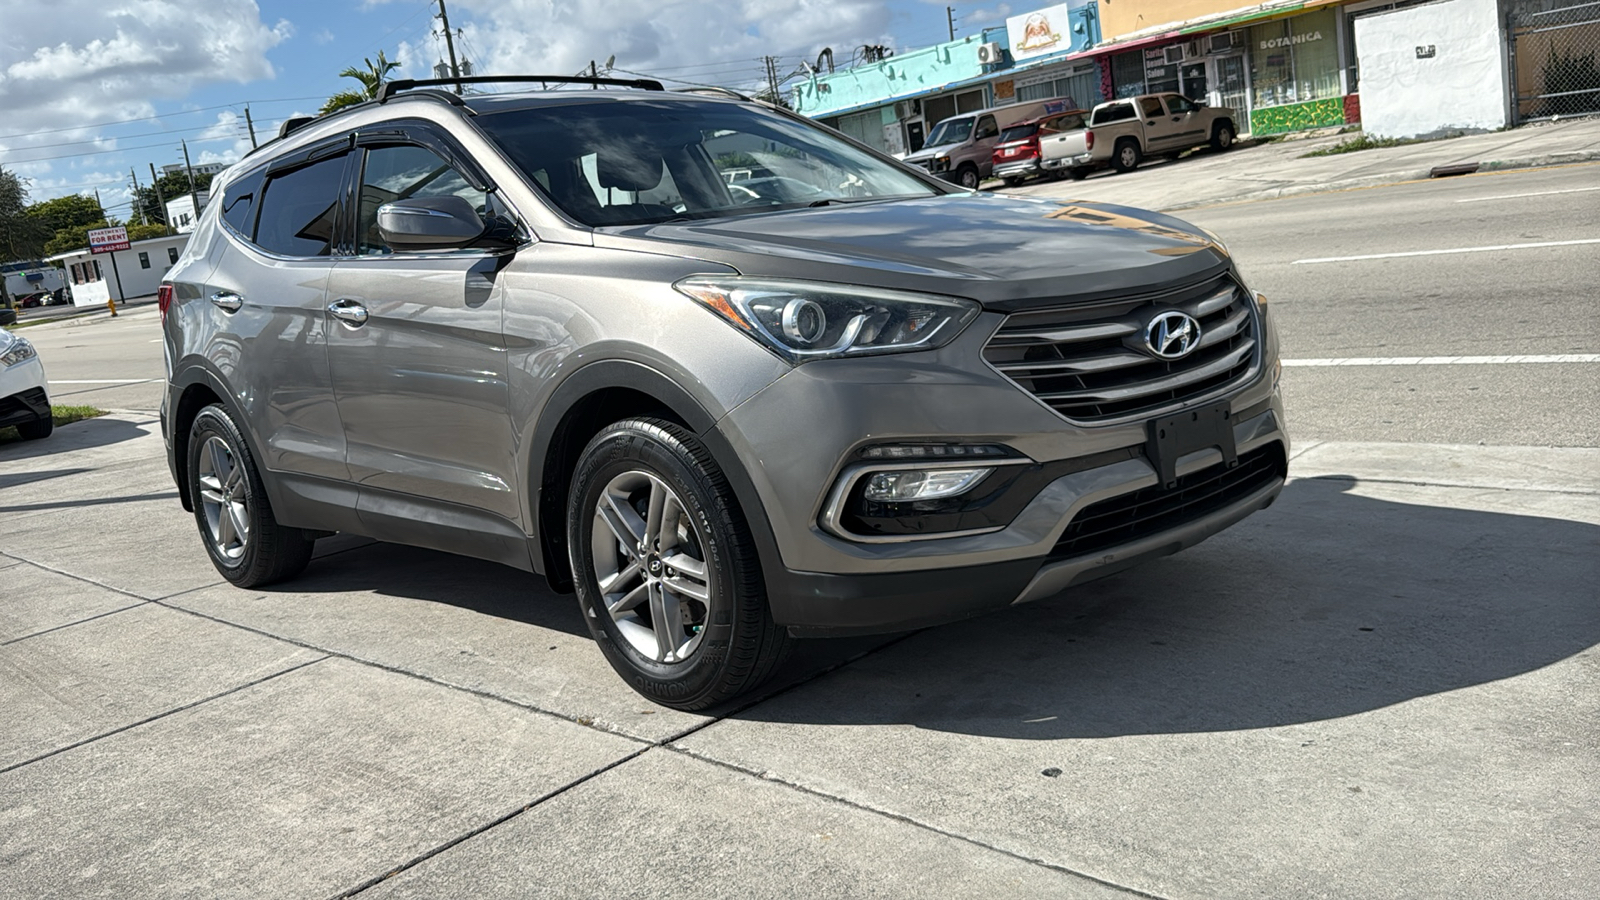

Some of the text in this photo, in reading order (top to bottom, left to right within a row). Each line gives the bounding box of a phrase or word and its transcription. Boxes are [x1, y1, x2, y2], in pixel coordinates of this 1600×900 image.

[1259, 30, 1322, 49] BOTANICA
[1147, 68, 1165, 79] Salon
[90, 228, 125, 237] APARTMENTS
[91, 233, 126, 244] FOR RENT
[634, 674, 691, 697] KUMHO
